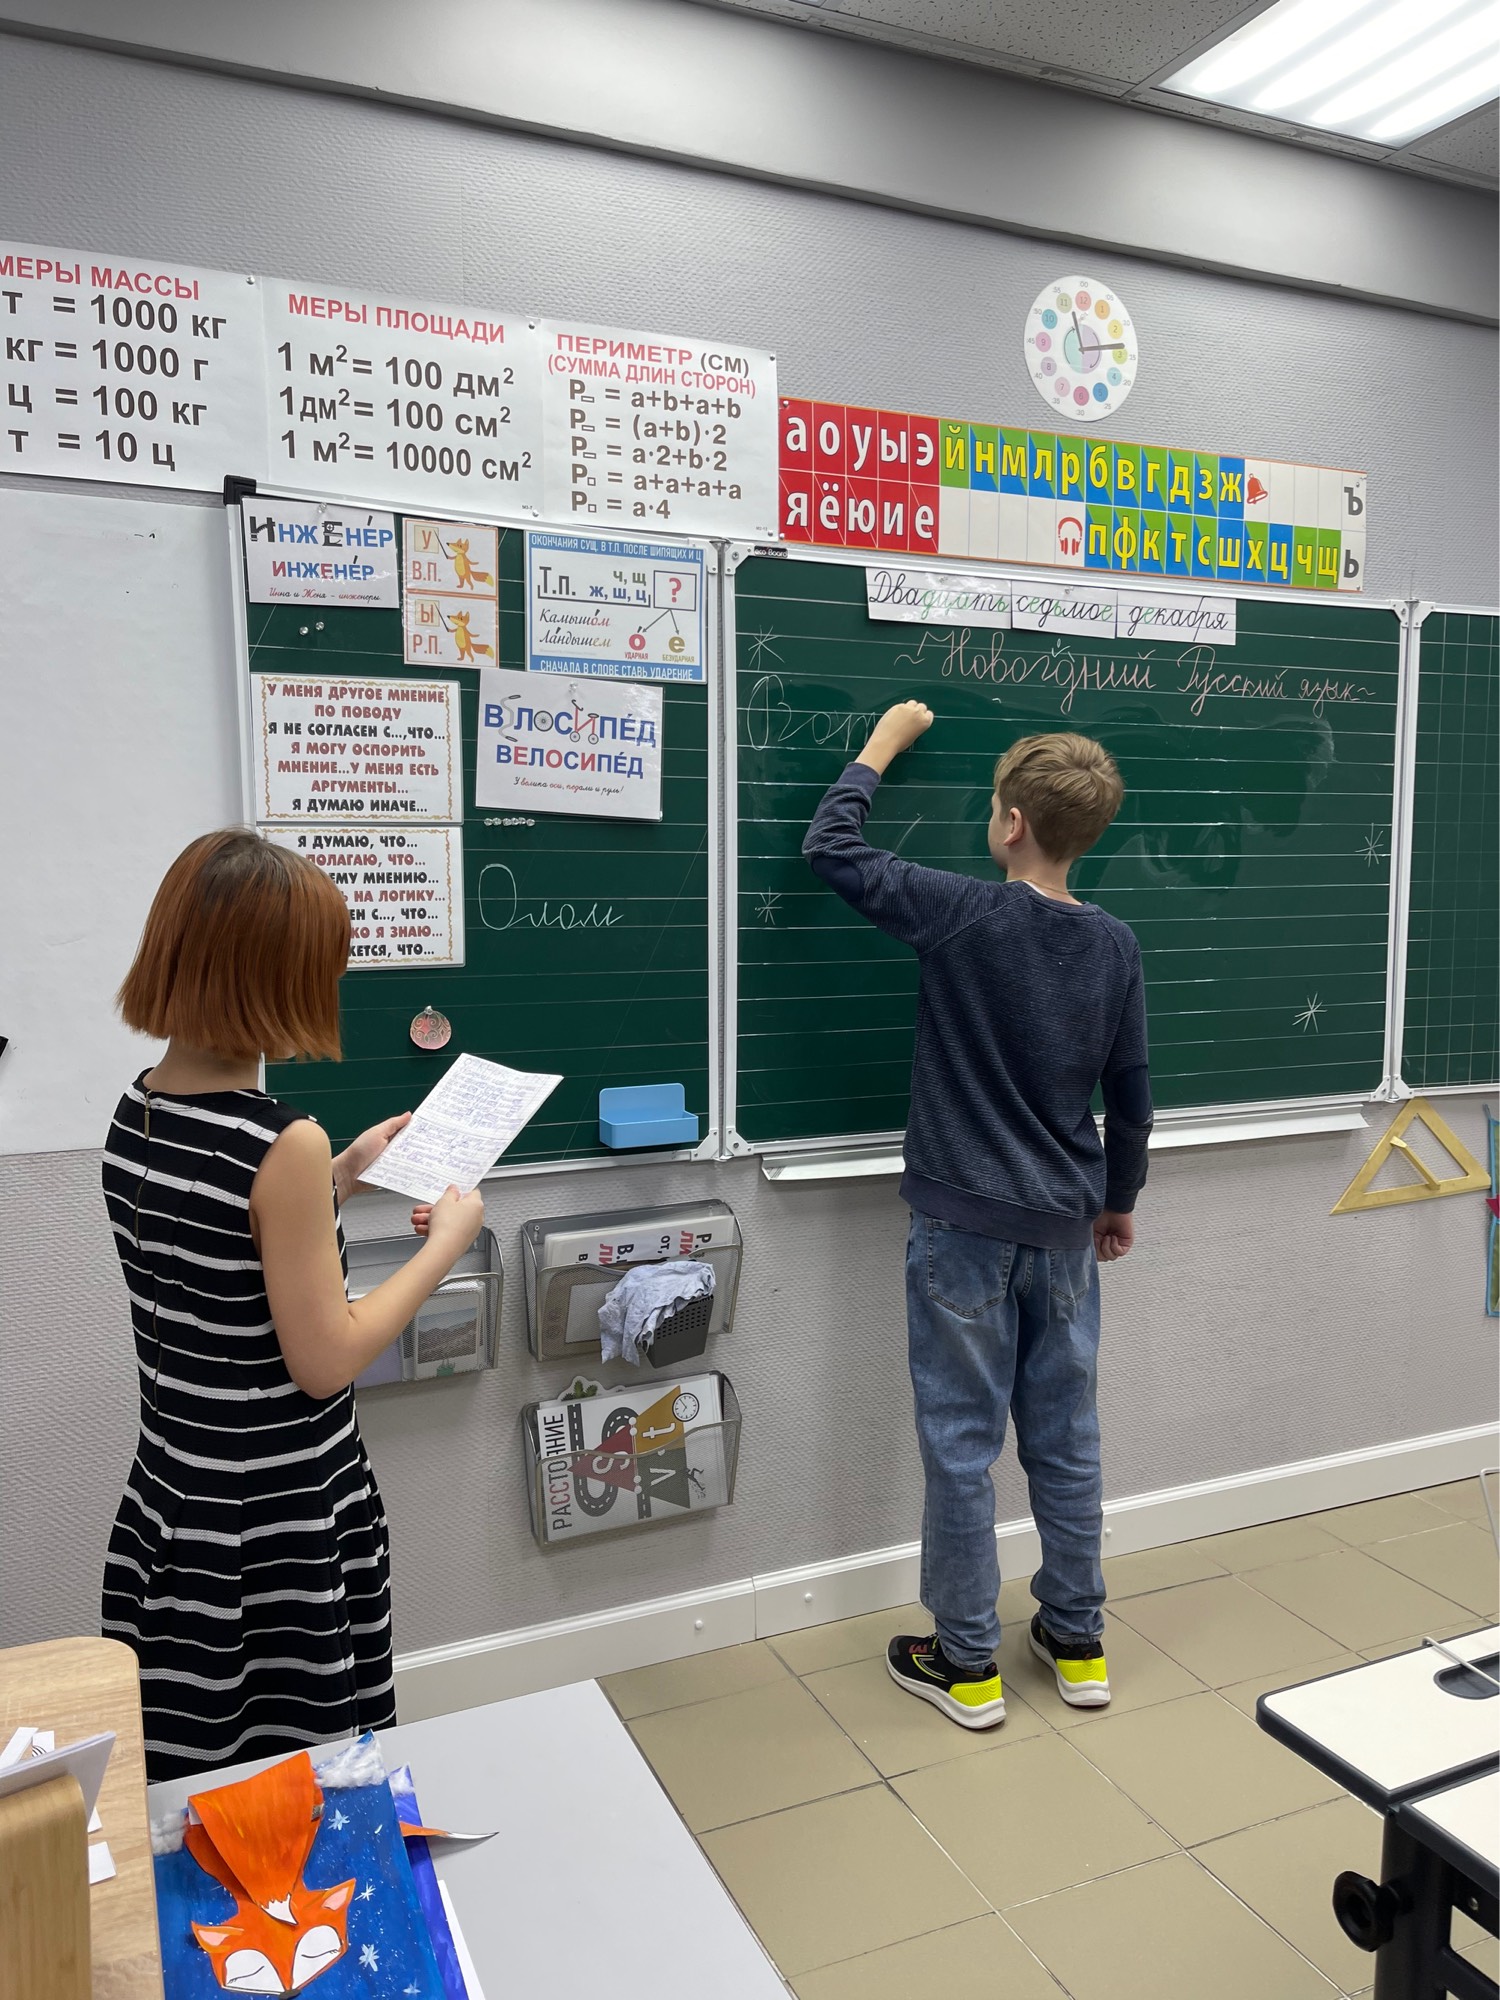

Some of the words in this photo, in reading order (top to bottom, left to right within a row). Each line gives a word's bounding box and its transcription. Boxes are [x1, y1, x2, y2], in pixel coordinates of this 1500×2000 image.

[0, 255, 80, 284] МЕРЫ
[91, 266, 199, 300] МАССЫ
[91, 295, 177, 333] 1000
[192, 315, 227, 339] кг
[289, 294, 367, 324] МЕРЫ
[376, 307, 505, 344] ПЛОЩАДИ
[6, 338, 43, 361] кг
[92, 340, 179, 377] 1000
[195, 359, 208, 380] г
[557, 334, 692, 365] ПЕРИМЕТР
[701, 352, 749, 378] (СМ)
[277, 342, 292, 371] 1
[386, 357, 442, 390] 100
[548, 354, 621, 379] (СУММА
[625, 363, 676, 385] ДЛИН
[681, 371, 756, 398] СТОРОН)
[8, 384, 32, 413] ц
[93, 385, 157, 420] 100
[172, 402, 207, 425] кг
[387, 400, 443, 431] 100
[95, 430, 138, 461] 10
[152, 444, 175, 471] ц
[281, 431, 296, 458] 1
[386, 442, 471, 476] 10000
[532, 534, 578, 549] ОКОНЧАНИЯ
[581, 539, 598, 552] СУЩ.
[601, 540, 605, 550] В
[608, 541, 621, 552] Т.П.
[624, 543, 647, 555] ПОСЛЕ
[650, 545, 686, 560] ШИПЯЩИХ
[688, 551, 693, 560] И
[696, 551, 701, 562] Ц
[413, 560, 441, 582] В.П.
[421, 604, 433, 623] Ы
[870, 571, 1009, 619] Двадцать
[1016, 592, 1112, 628] седьмое
[1128, 596, 1228, 642] декабря
[413, 634, 442, 655] Р.П.
[625, 652, 648, 660] УДАРНАЯ
[662, 654, 695, 663] БЕЗУДАРНАЯ
[540, 660, 581, 673] СНАЧАЛА
[584, 663, 589, 673] В
[591, 664, 619, 675] СЛОВЕ
[622, 665, 648, 678] СТАВЬ
[650, 667, 693, 680] УДАРЕНИЕ
[267, 684, 277, 695] У
[283, 685, 322, 698] МЕНЯ
[328, 687, 382, 701] ДРУГОЕ
[388, 689, 444, 702] МНЕНИЕ
[315, 705, 335, 717] ПО
[342, 706, 401, 721] ПОВОДУ
[269, 723, 277, 734] Я
[284, 723, 302, 734] НЕ
[308, 723, 377, 737] СОГЛАСЕН
[291, 742, 300, 754] Я
[307, 743, 347, 754] МОГУ
[353, 744, 425, 757] ОСПОРИТЬ
[365, 764, 403, 775] МЕНЯ
[410, 764, 439, 775] ЕСТЬ
[312, 781, 408, 794] АРГУМЕНТЫ...
[293, 799, 301, 810] Я
[307, 800, 364, 812] ДУМАЮ
[371, 801, 427, 812] ИНАЧЕ...
[298, 836, 306, 847] Я
[313, 836, 374, 849] ДУМАЮ,
[380, 836, 417, 848] ЧТО...
[305, 854, 382, 867] ПОЛАГАЮ,
[388, 854, 425, 866] ЧТО...
[364, 872, 439, 884] МНЕНИЮ...
[354, 890, 373, 902] НА
[379, 890, 445, 902] ЛОГИКУ...
[401, 908, 438, 920] ЧТО...
[376, 927, 384, 937] Я
[390, 926, 442, 938] ЗНАЮ...
[397, 944, 434, 956] ЧТО...
